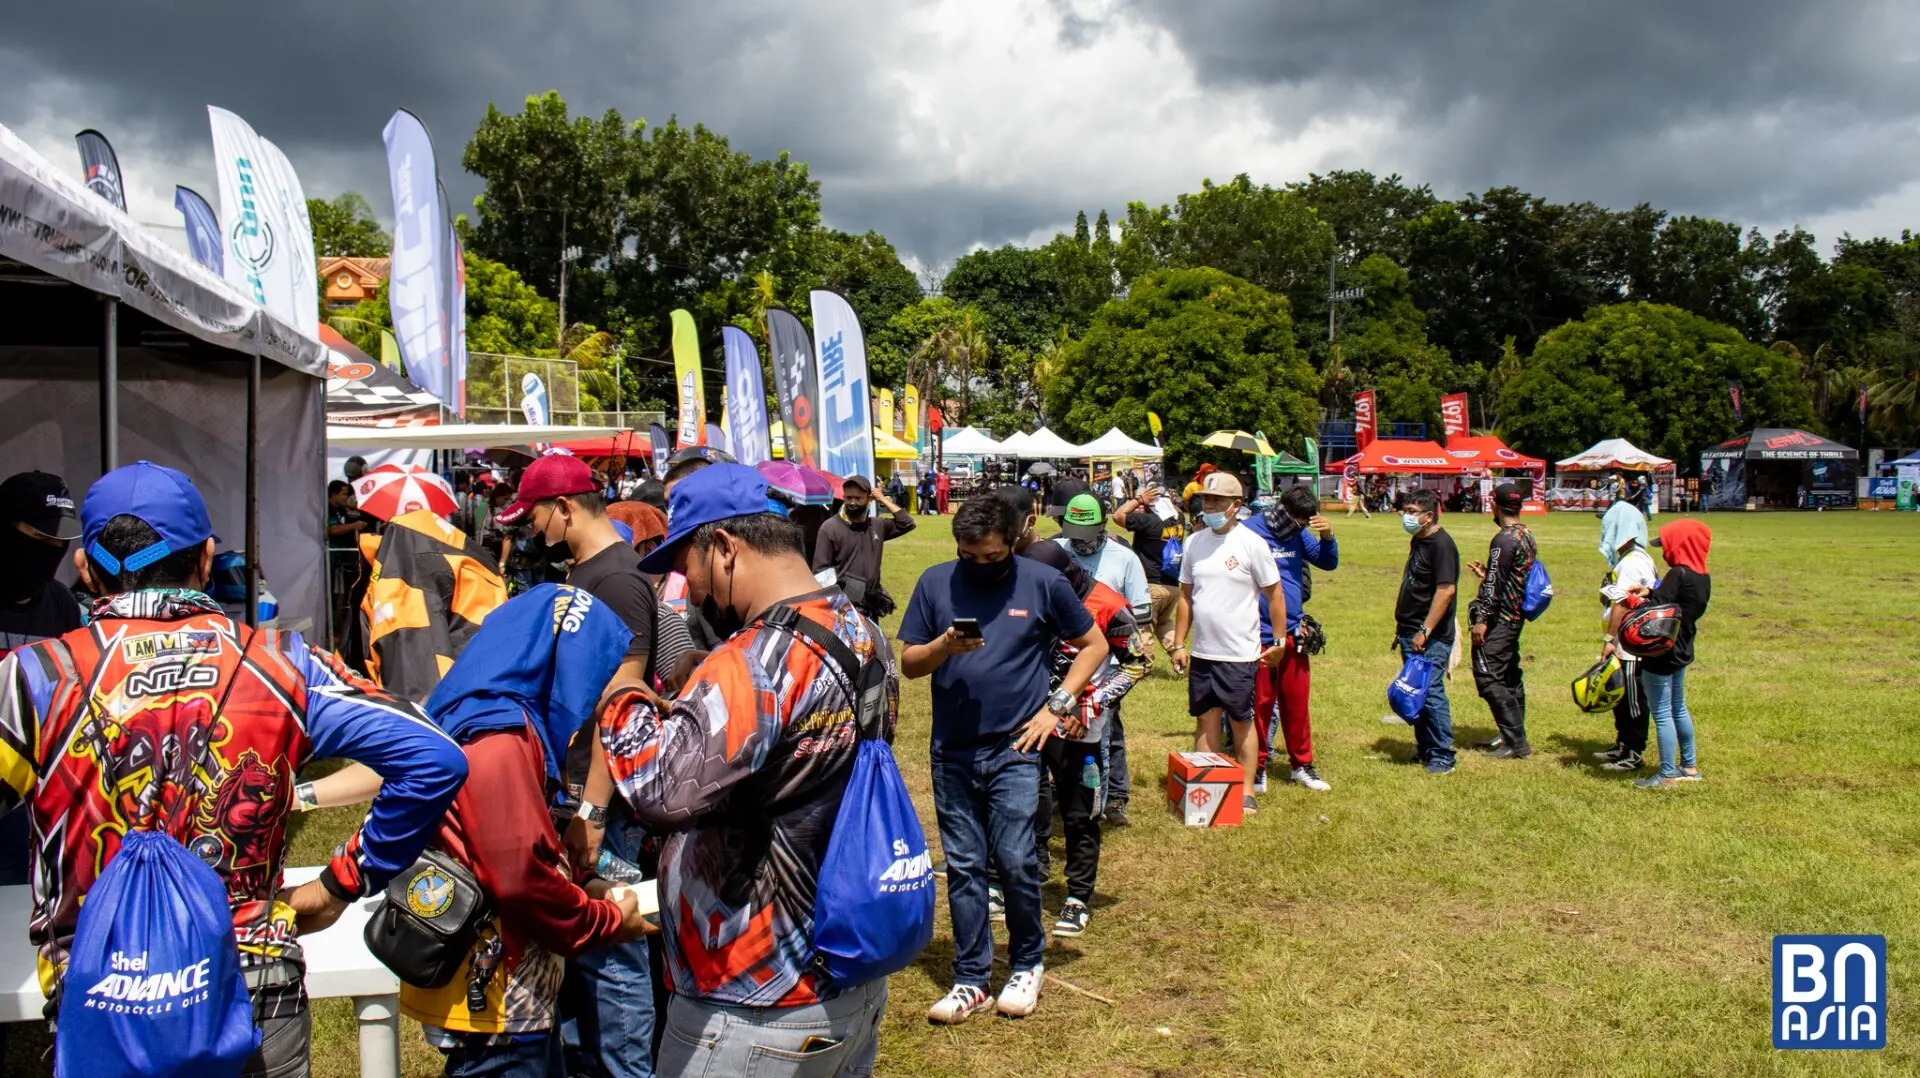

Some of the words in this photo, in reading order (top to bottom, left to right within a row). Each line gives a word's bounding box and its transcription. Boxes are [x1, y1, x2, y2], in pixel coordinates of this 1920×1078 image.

[1441, 400, 1464, 435] 1974
[1761, 451, 1776, 459] THE
[1777, 451, 1808, 459] SCIENCE
[1808, 451, 1818, 459] OF
[1819, 451, 1844, 459] THRILL
[1533, 480, 1546, 502] 974
[561, 587, 593, 633] ONG
[136, 639, 154, 656] AM
[127, 663, 219, 697] NILO
[87, 958, 210, 1001] ADVANCE
[85, 1000, 172, 1016] MOTORCYCLE
[182, 991, 209, 1009] OILS
